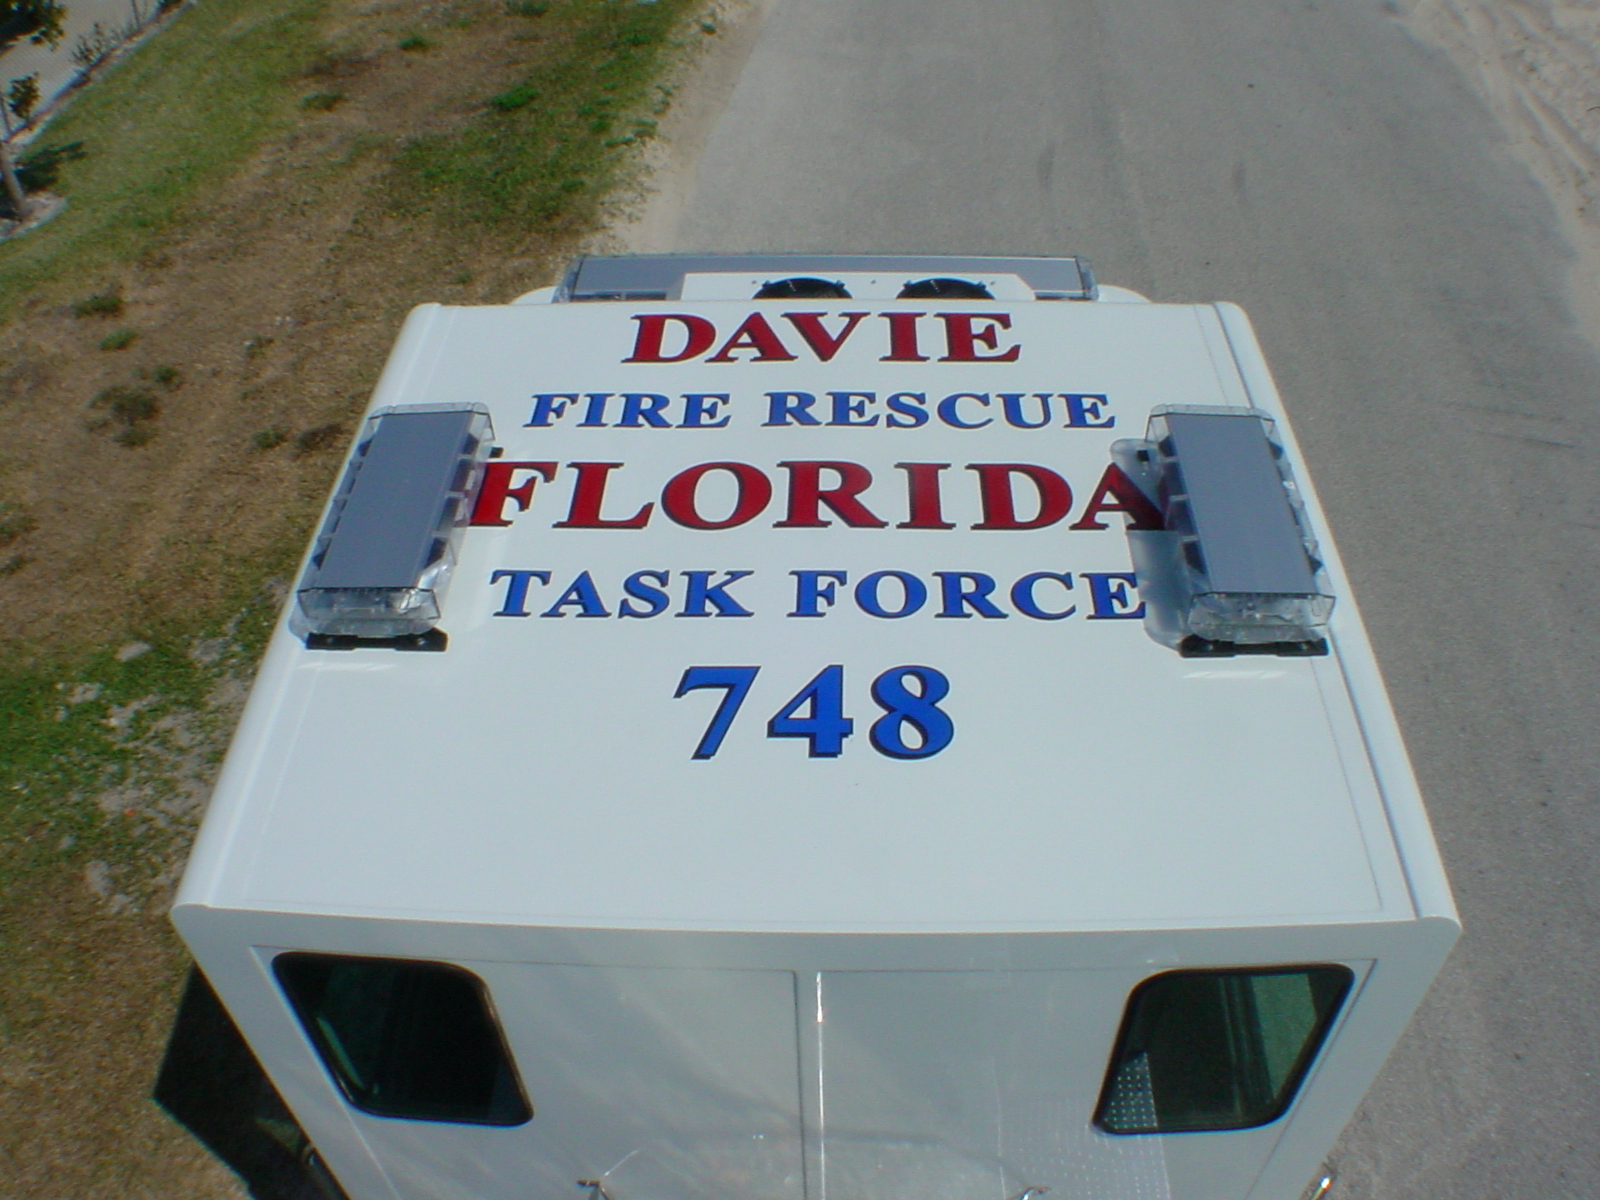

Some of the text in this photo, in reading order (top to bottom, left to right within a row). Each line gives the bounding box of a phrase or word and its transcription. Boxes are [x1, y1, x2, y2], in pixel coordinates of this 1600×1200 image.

[621, 312, 1020, 363] DAVIE
[524, 391, 1116, 430] FIRE RESCUE
[466, 461, 1166, 531] FLORIDA
[490, 569, 1147, 620] TASK FORCE
[673, 664, 955, 760] 748
